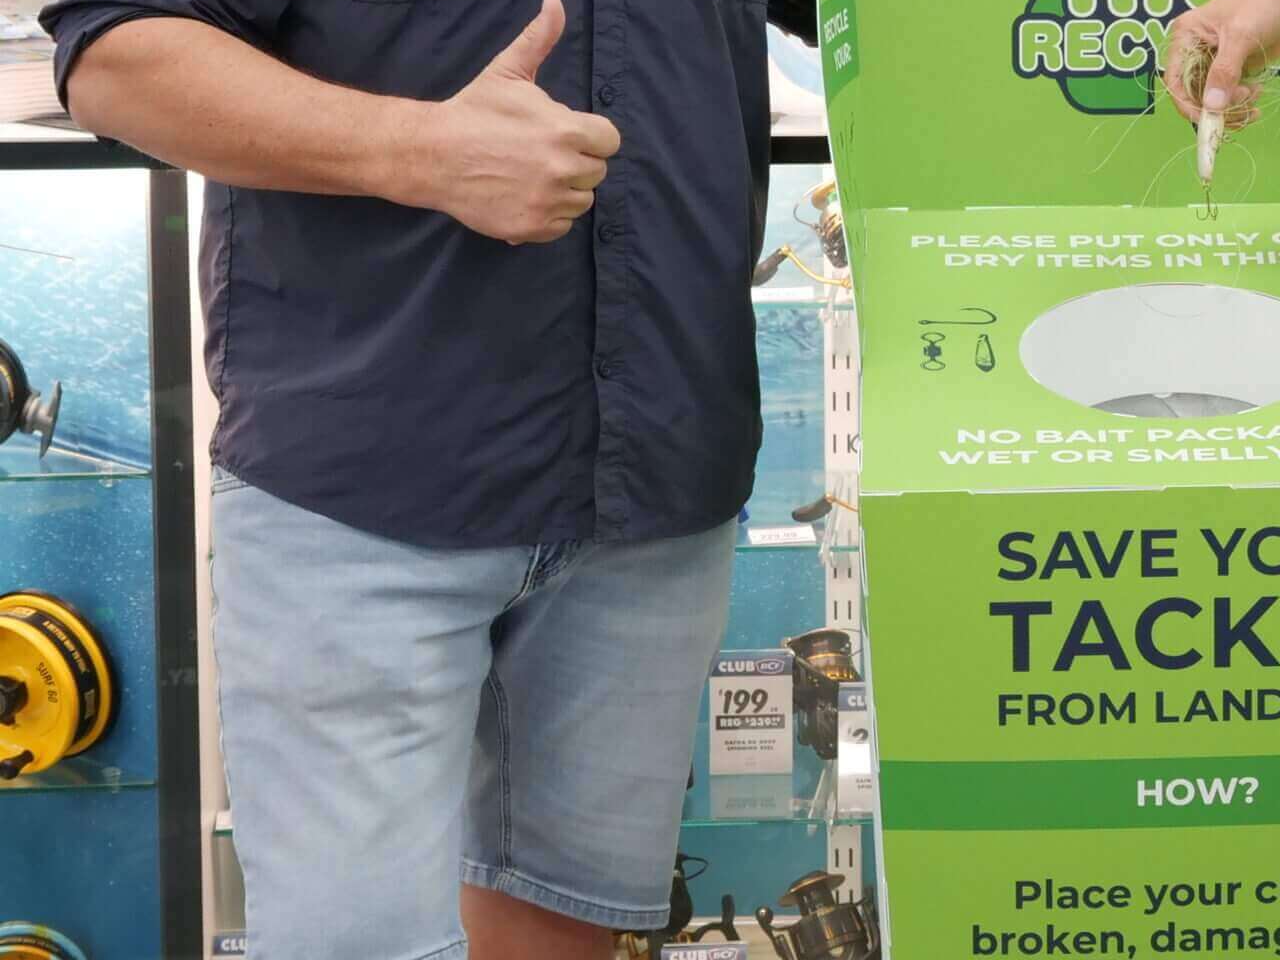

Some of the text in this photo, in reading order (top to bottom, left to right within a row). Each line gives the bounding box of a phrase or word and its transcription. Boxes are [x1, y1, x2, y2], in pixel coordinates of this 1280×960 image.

[823, 8, 849, 43] RECYCLE
[911, 235, 1057, 248] PLEASE
[1070, 234, 1144, 248] PUT
[1156, 232, 1261, 247] ONLY
[945, 253, 1024, 267] DRY
[1037, 253, 1152, 268] ITEMS
[1164, 252, 1202, 268] IN
[957, 429, 1022, 444] NO
[1036, 428, 1134, 443] BAIT
[938, 450, 1038, 465] WET
[1051, 449, 1113, 462] OR
[997, 529, 1179, 581] SAVE
[718, 661, 755, 672] CLUB
[998, 691, 1136, 726] FROM
[1136, 776, 1259, 807] HOW?
[1014, 878, 1131, 910] Place
[1144, 878, 1242, 915] your
[221, 938, 248, 951] CLU
[972, 925, 1136, 958] broken,
[669, 950, 707, 960] CLUB
